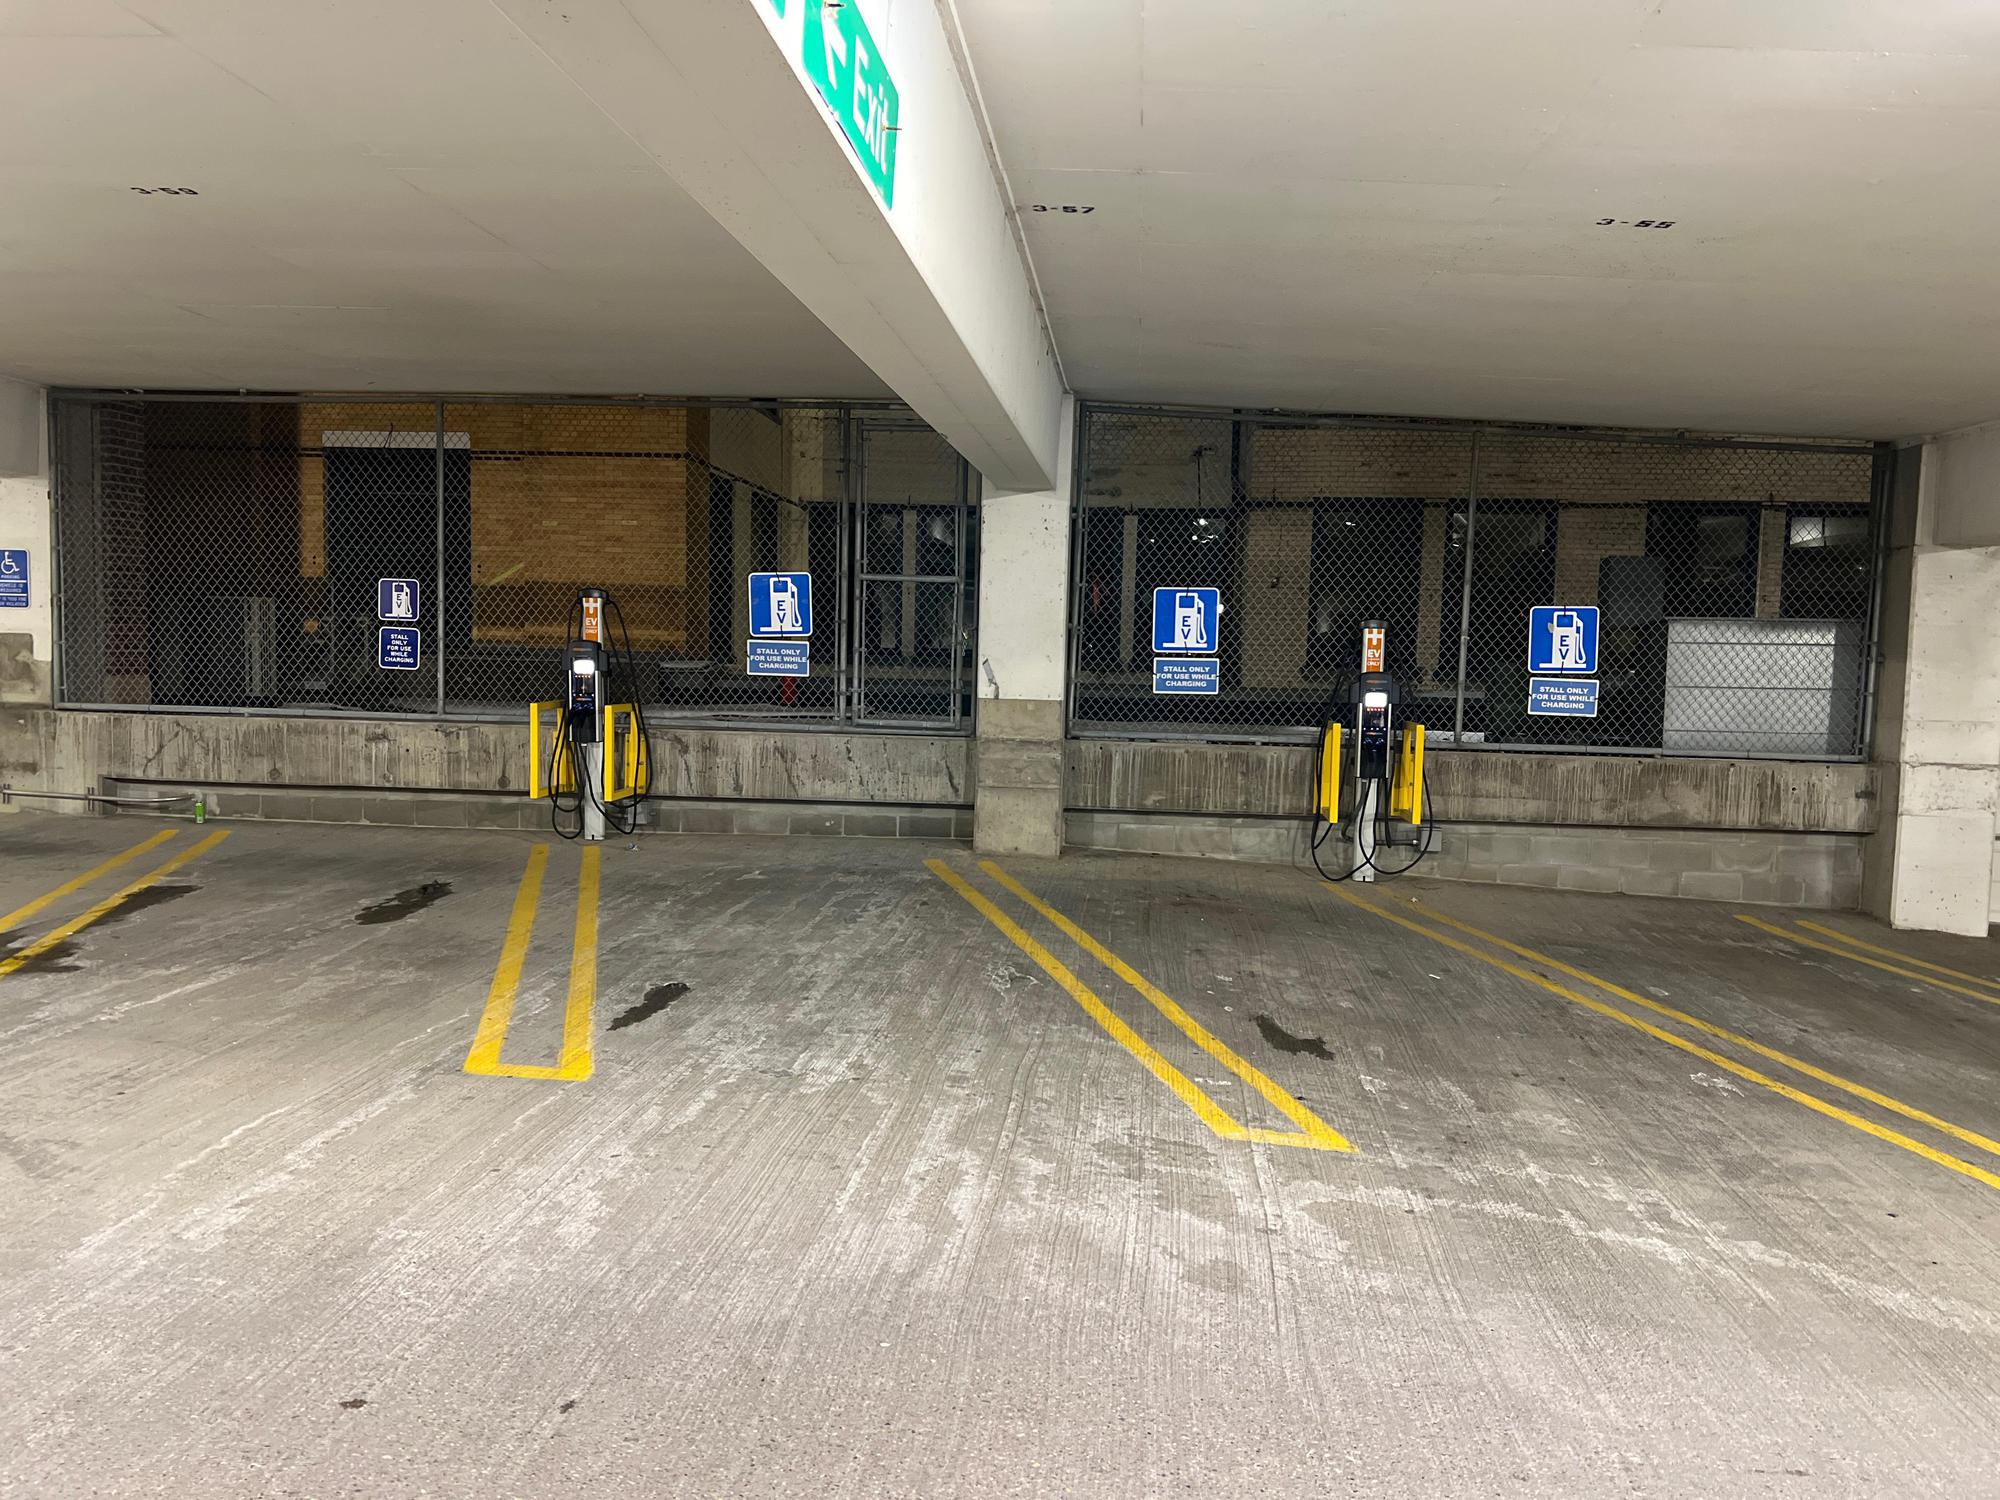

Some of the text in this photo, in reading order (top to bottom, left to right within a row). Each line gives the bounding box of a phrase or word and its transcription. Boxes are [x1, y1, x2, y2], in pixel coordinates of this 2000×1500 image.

[853, 34, 888, 175] Exit
[130, 187, 199, 195] 3-59
[1032, 205, 1095, 214] 3-57
[1596, 218, 1676, 229] 3-55
[396, 594, 402, 609] EV
[776, 600, 786, 624] EV
[585, 618, 598, 626] EV
[1181, 616, 1191, 640] EV
[1368, 649, 1380, 658] EV
[1559, 635, 1570, 660] EV
